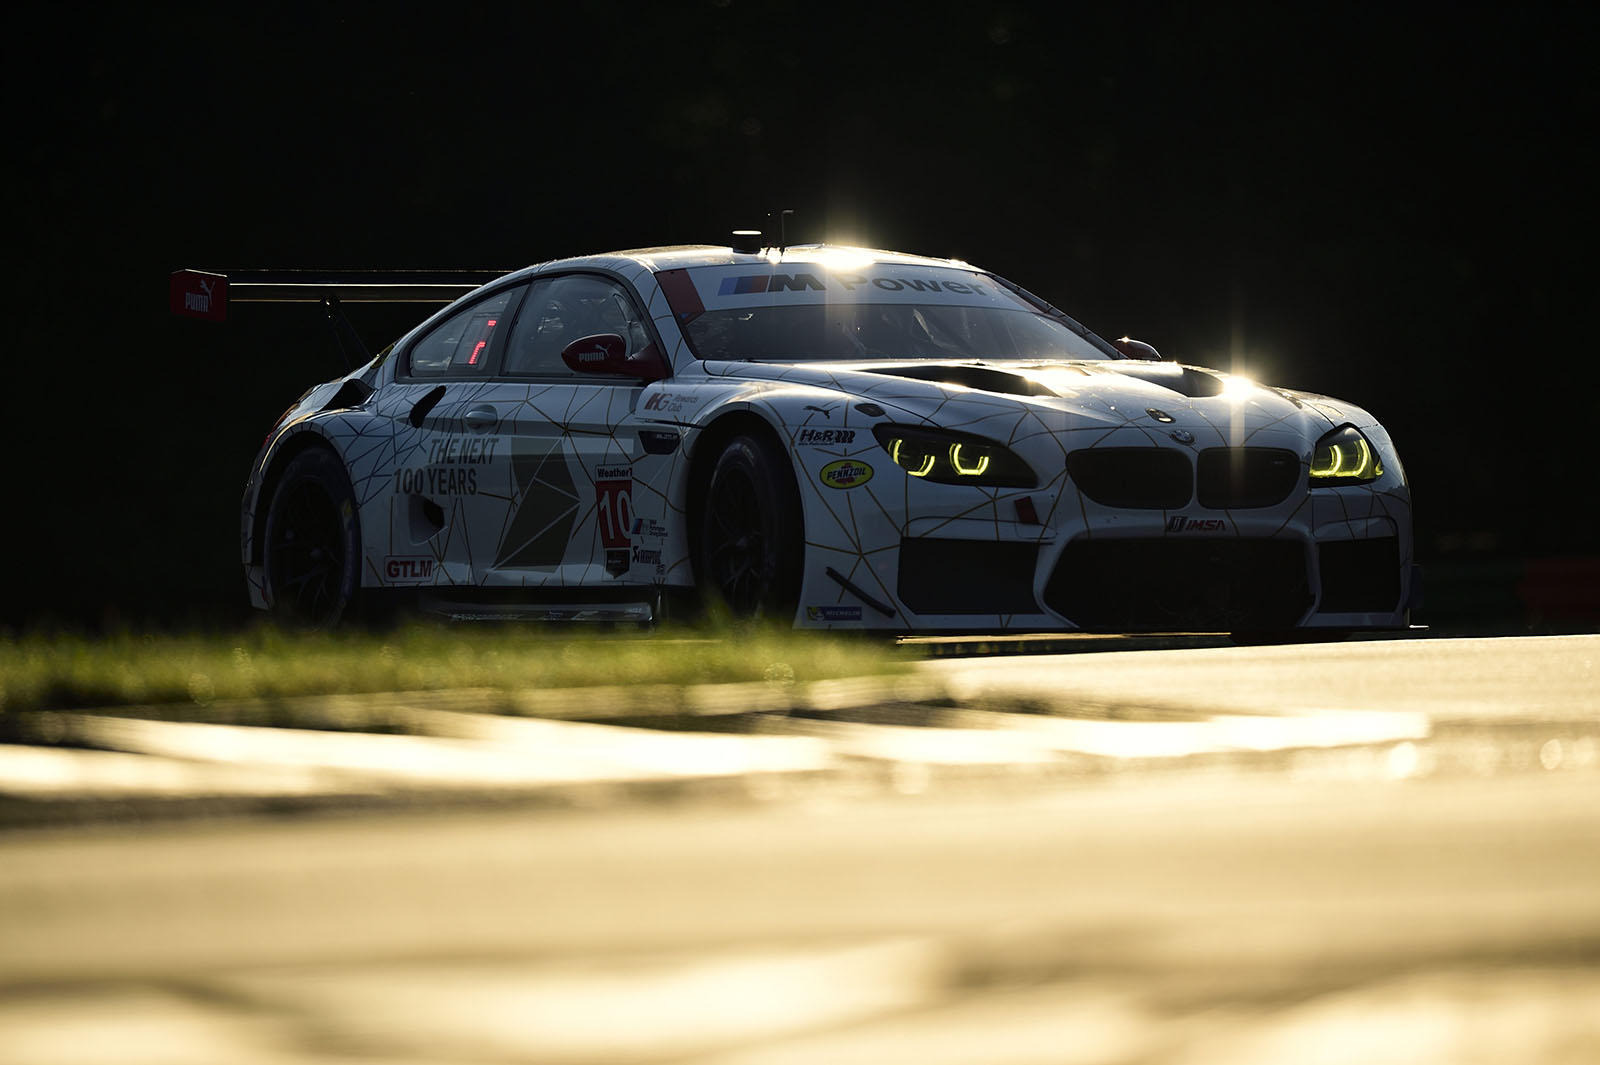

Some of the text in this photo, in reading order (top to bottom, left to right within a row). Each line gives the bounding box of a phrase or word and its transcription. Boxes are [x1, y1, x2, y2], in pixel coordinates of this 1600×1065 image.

[831, 273, 987, 297] Power
[185, 291, 209, 313] PUMA
[578, 351, 606, 363] PUMA
[800, 429, 834, 442] H&R
[428, 438, 500, 465] THE NEXT
[394, 467, 478, 496] 100 YEARS
[826, 466, 867, 481] PENNZOIL
[599, 489, 632, 541] 10
[1185, 519, 1227, 532] IMSA
[386, 559, 433, 578] GTLM
